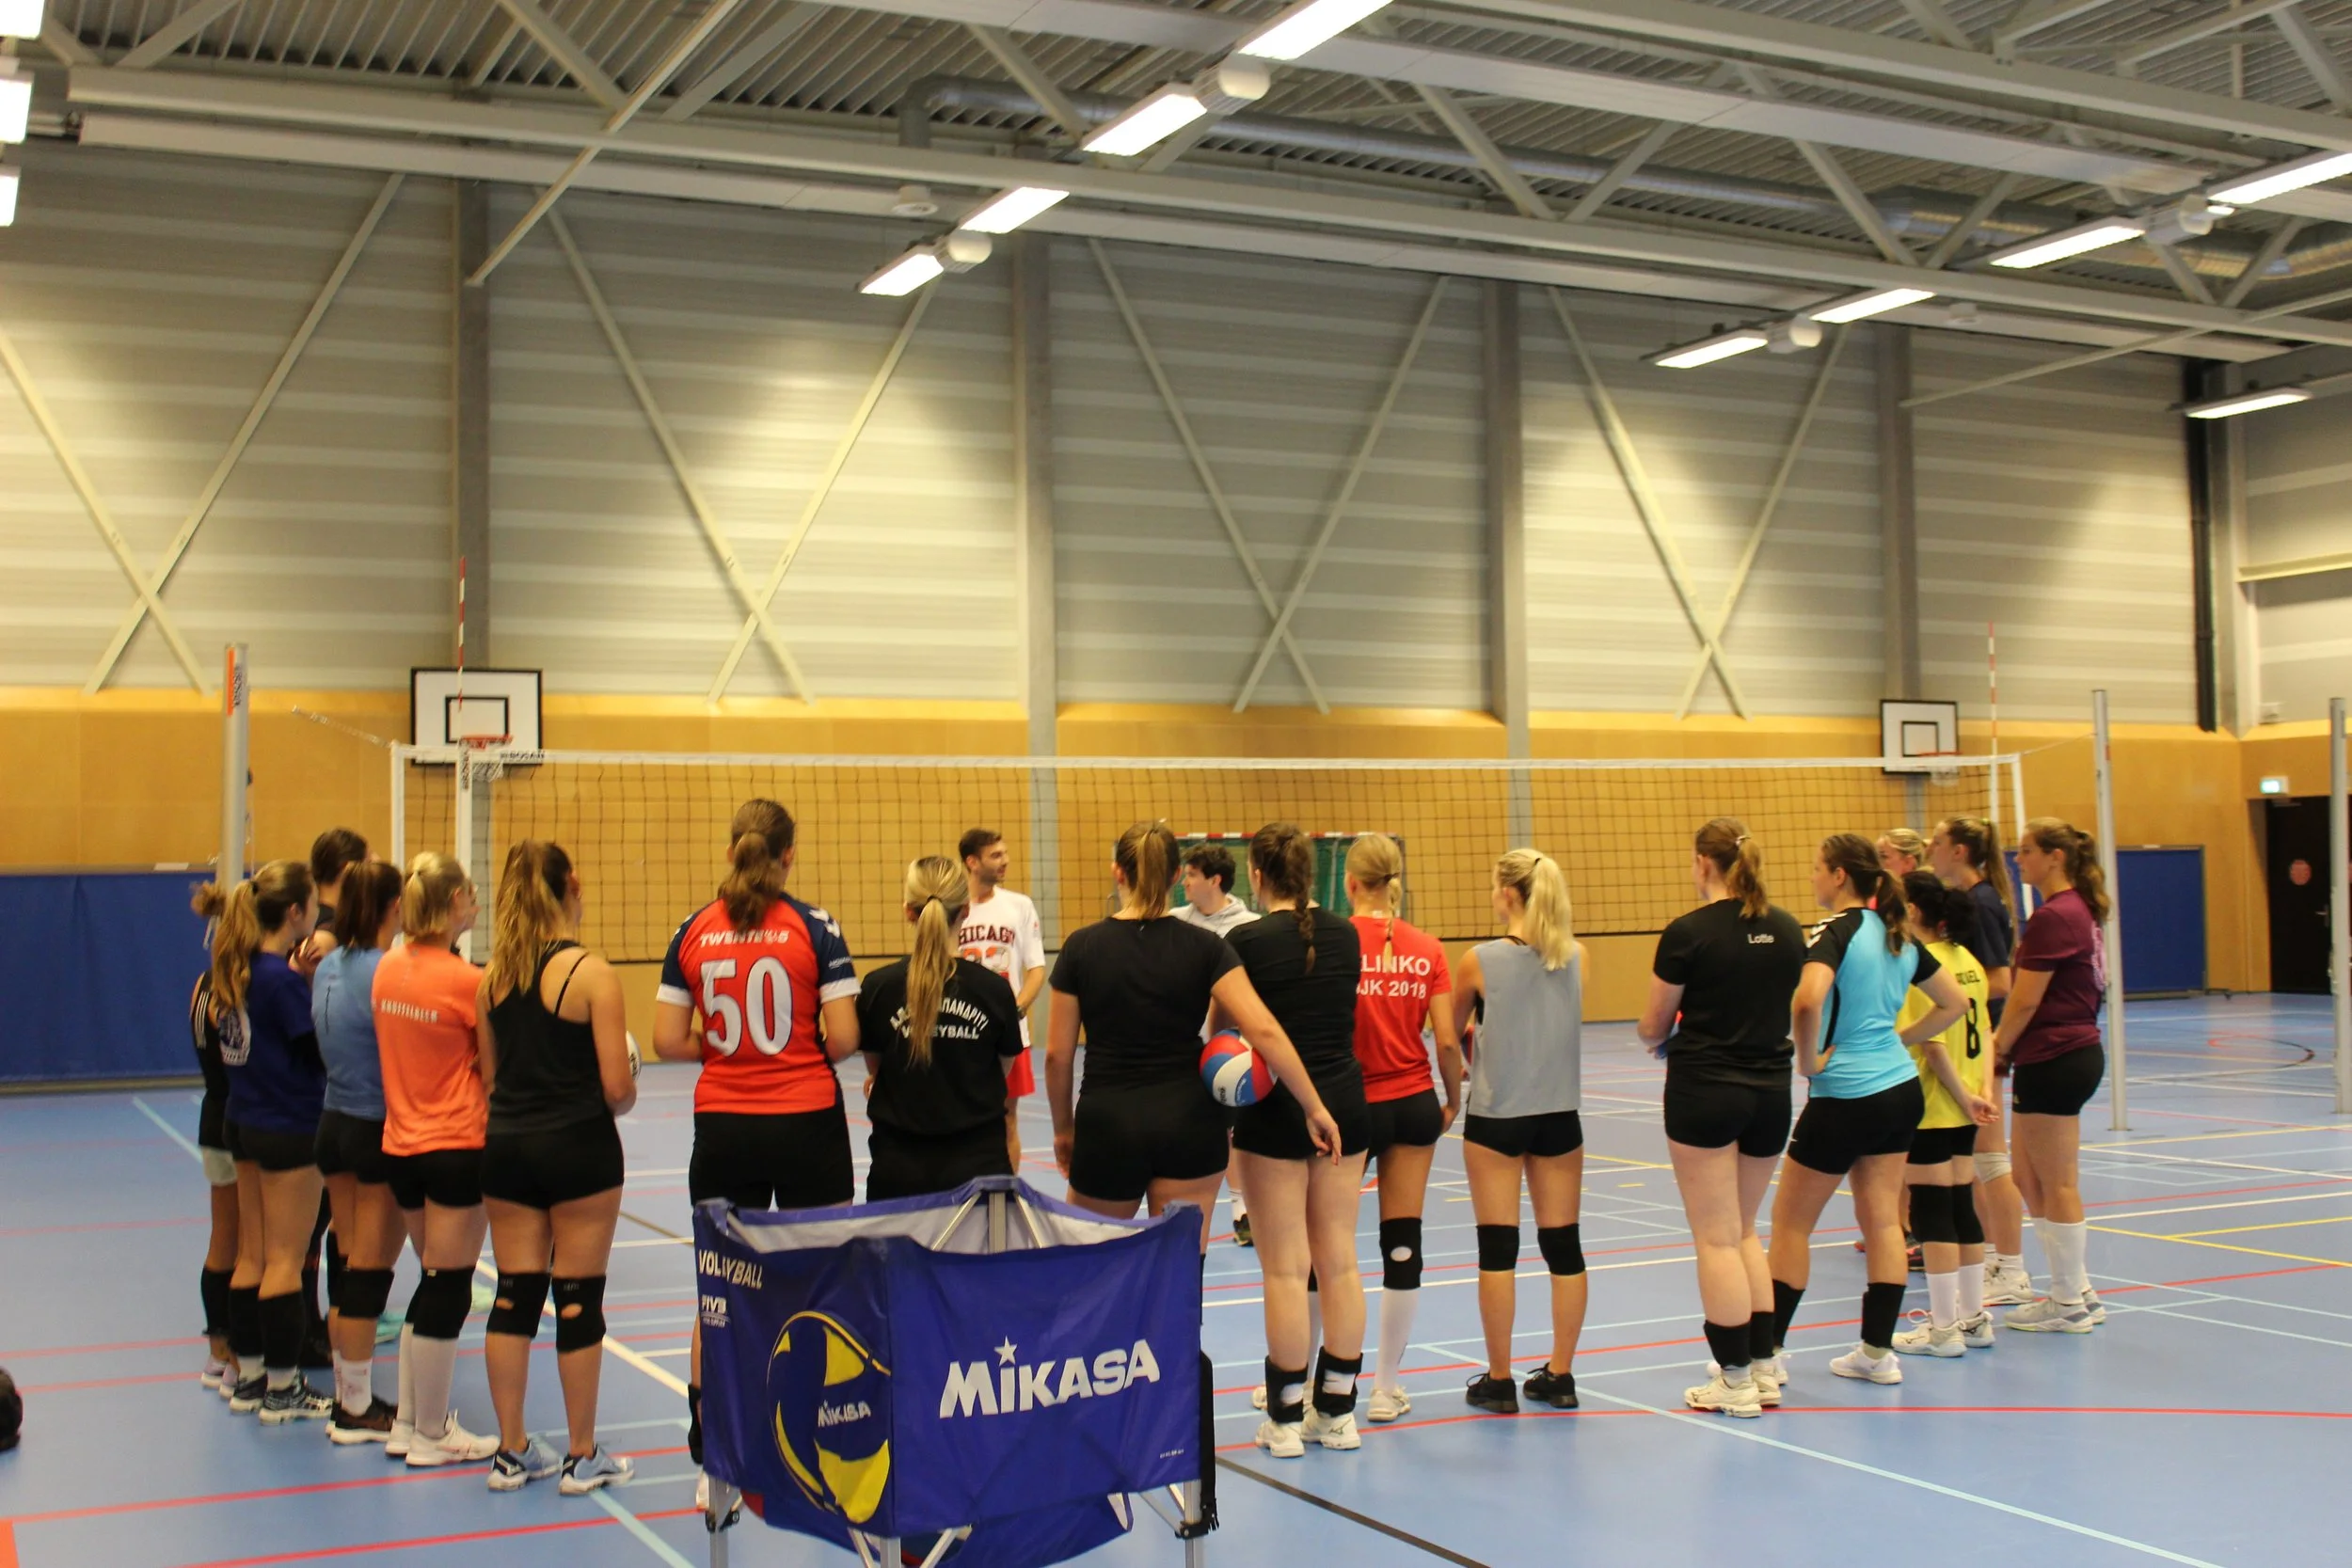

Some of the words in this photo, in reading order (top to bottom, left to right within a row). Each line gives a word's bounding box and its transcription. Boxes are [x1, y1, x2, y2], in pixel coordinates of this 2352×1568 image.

[958, 925, 1015, 946] HICAG
[1747, 933, 1774, 943] Lotte
[1360, 954, 1431, 976] LINKO
[1388, 980, 1427, 999] 2018
[701, 956, 793, 1056] 50
[1966, 997, 1980, 1059] 8
[940, 1335, 1160, 1418] MIKASA
